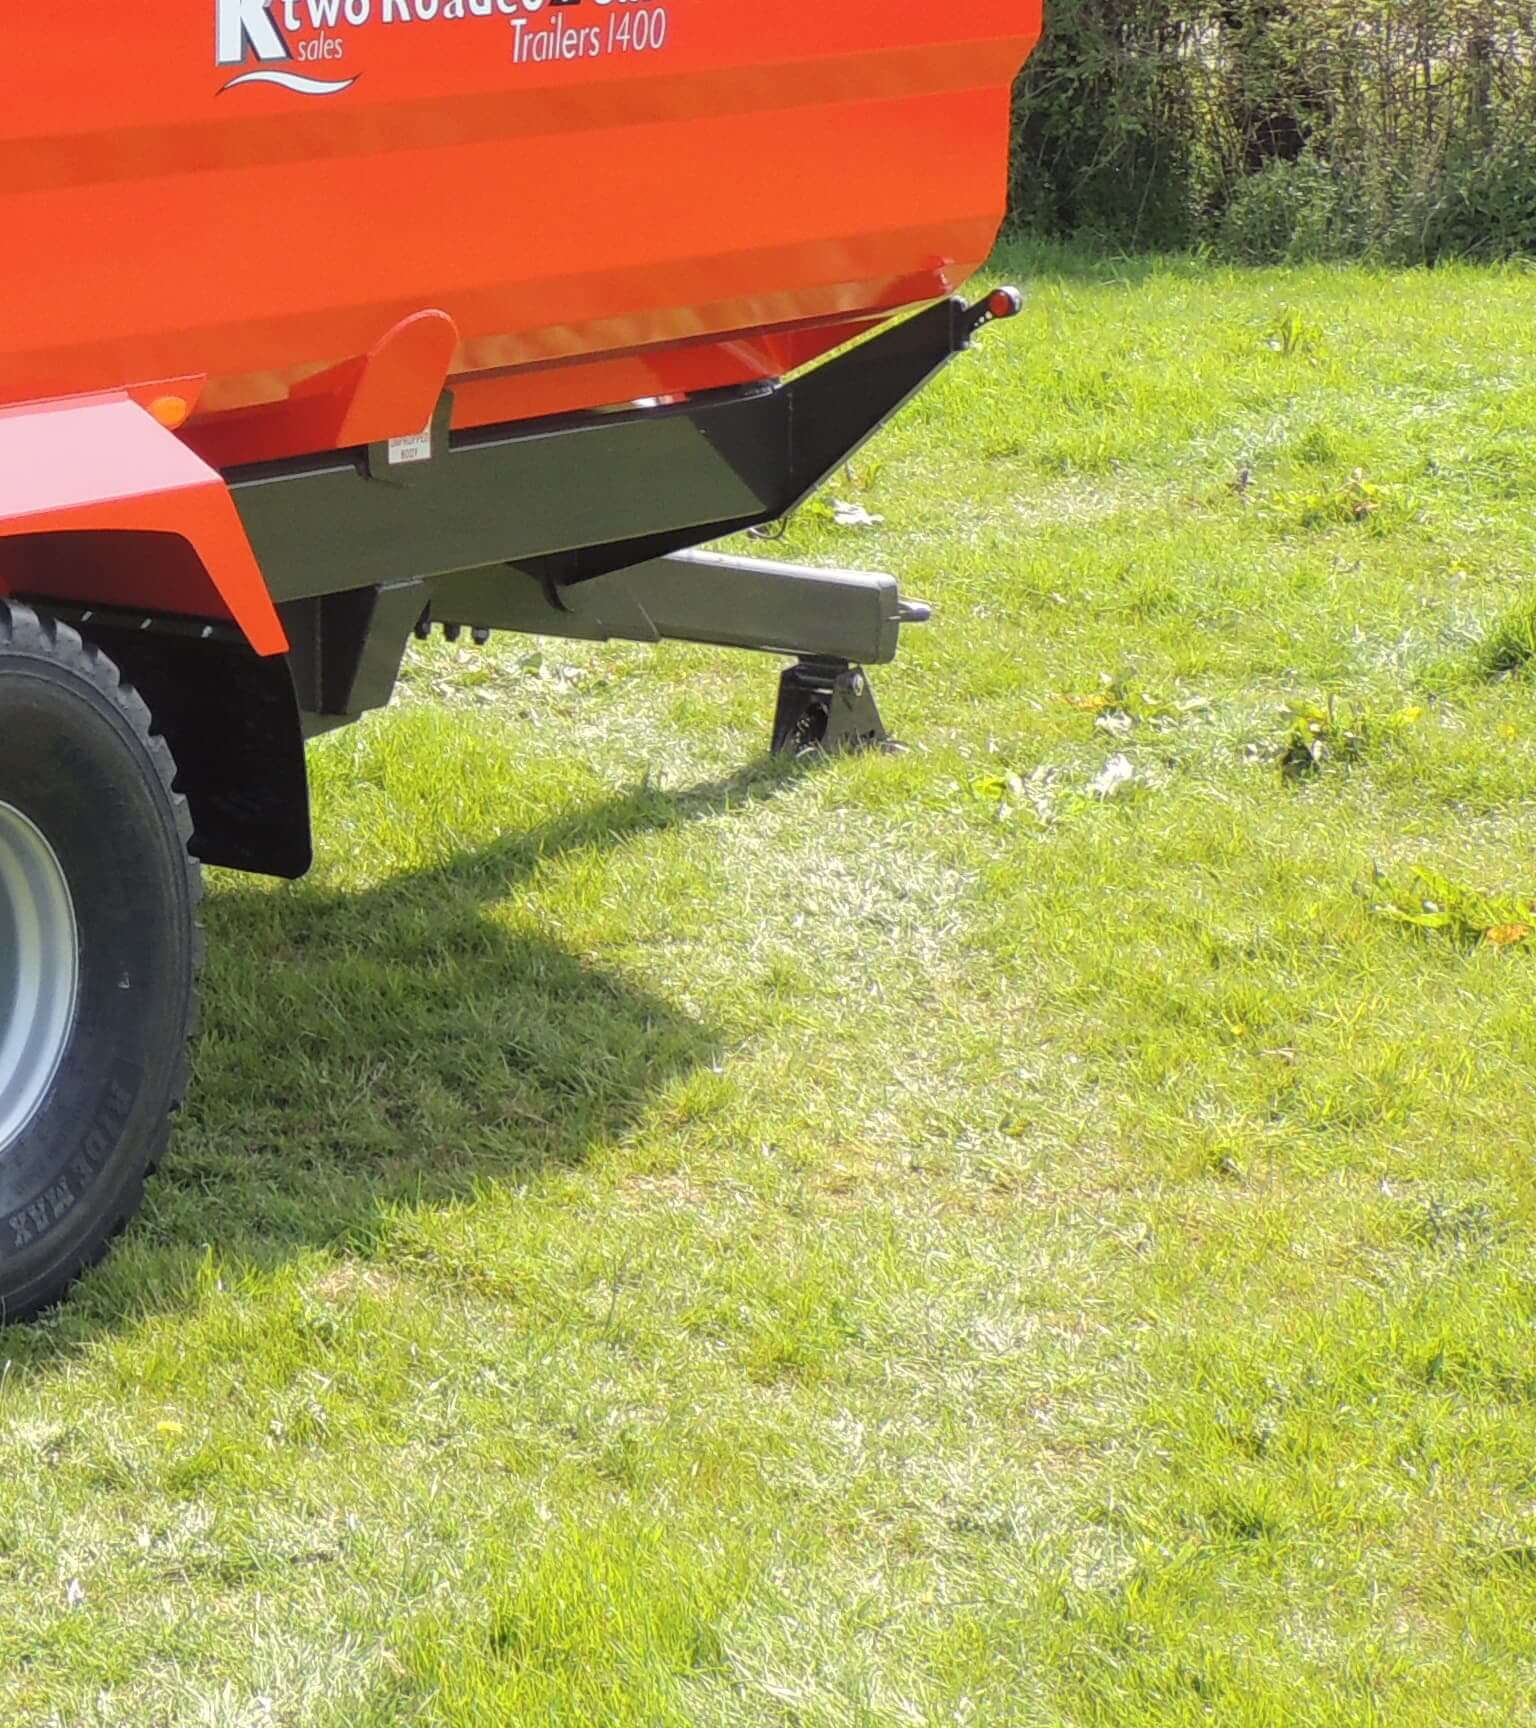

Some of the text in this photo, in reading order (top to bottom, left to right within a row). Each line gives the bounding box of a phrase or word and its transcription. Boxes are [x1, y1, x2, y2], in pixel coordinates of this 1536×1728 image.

[297, 30, 343, 62] sales
[510, 7, 666, 64] Trailers 1400
